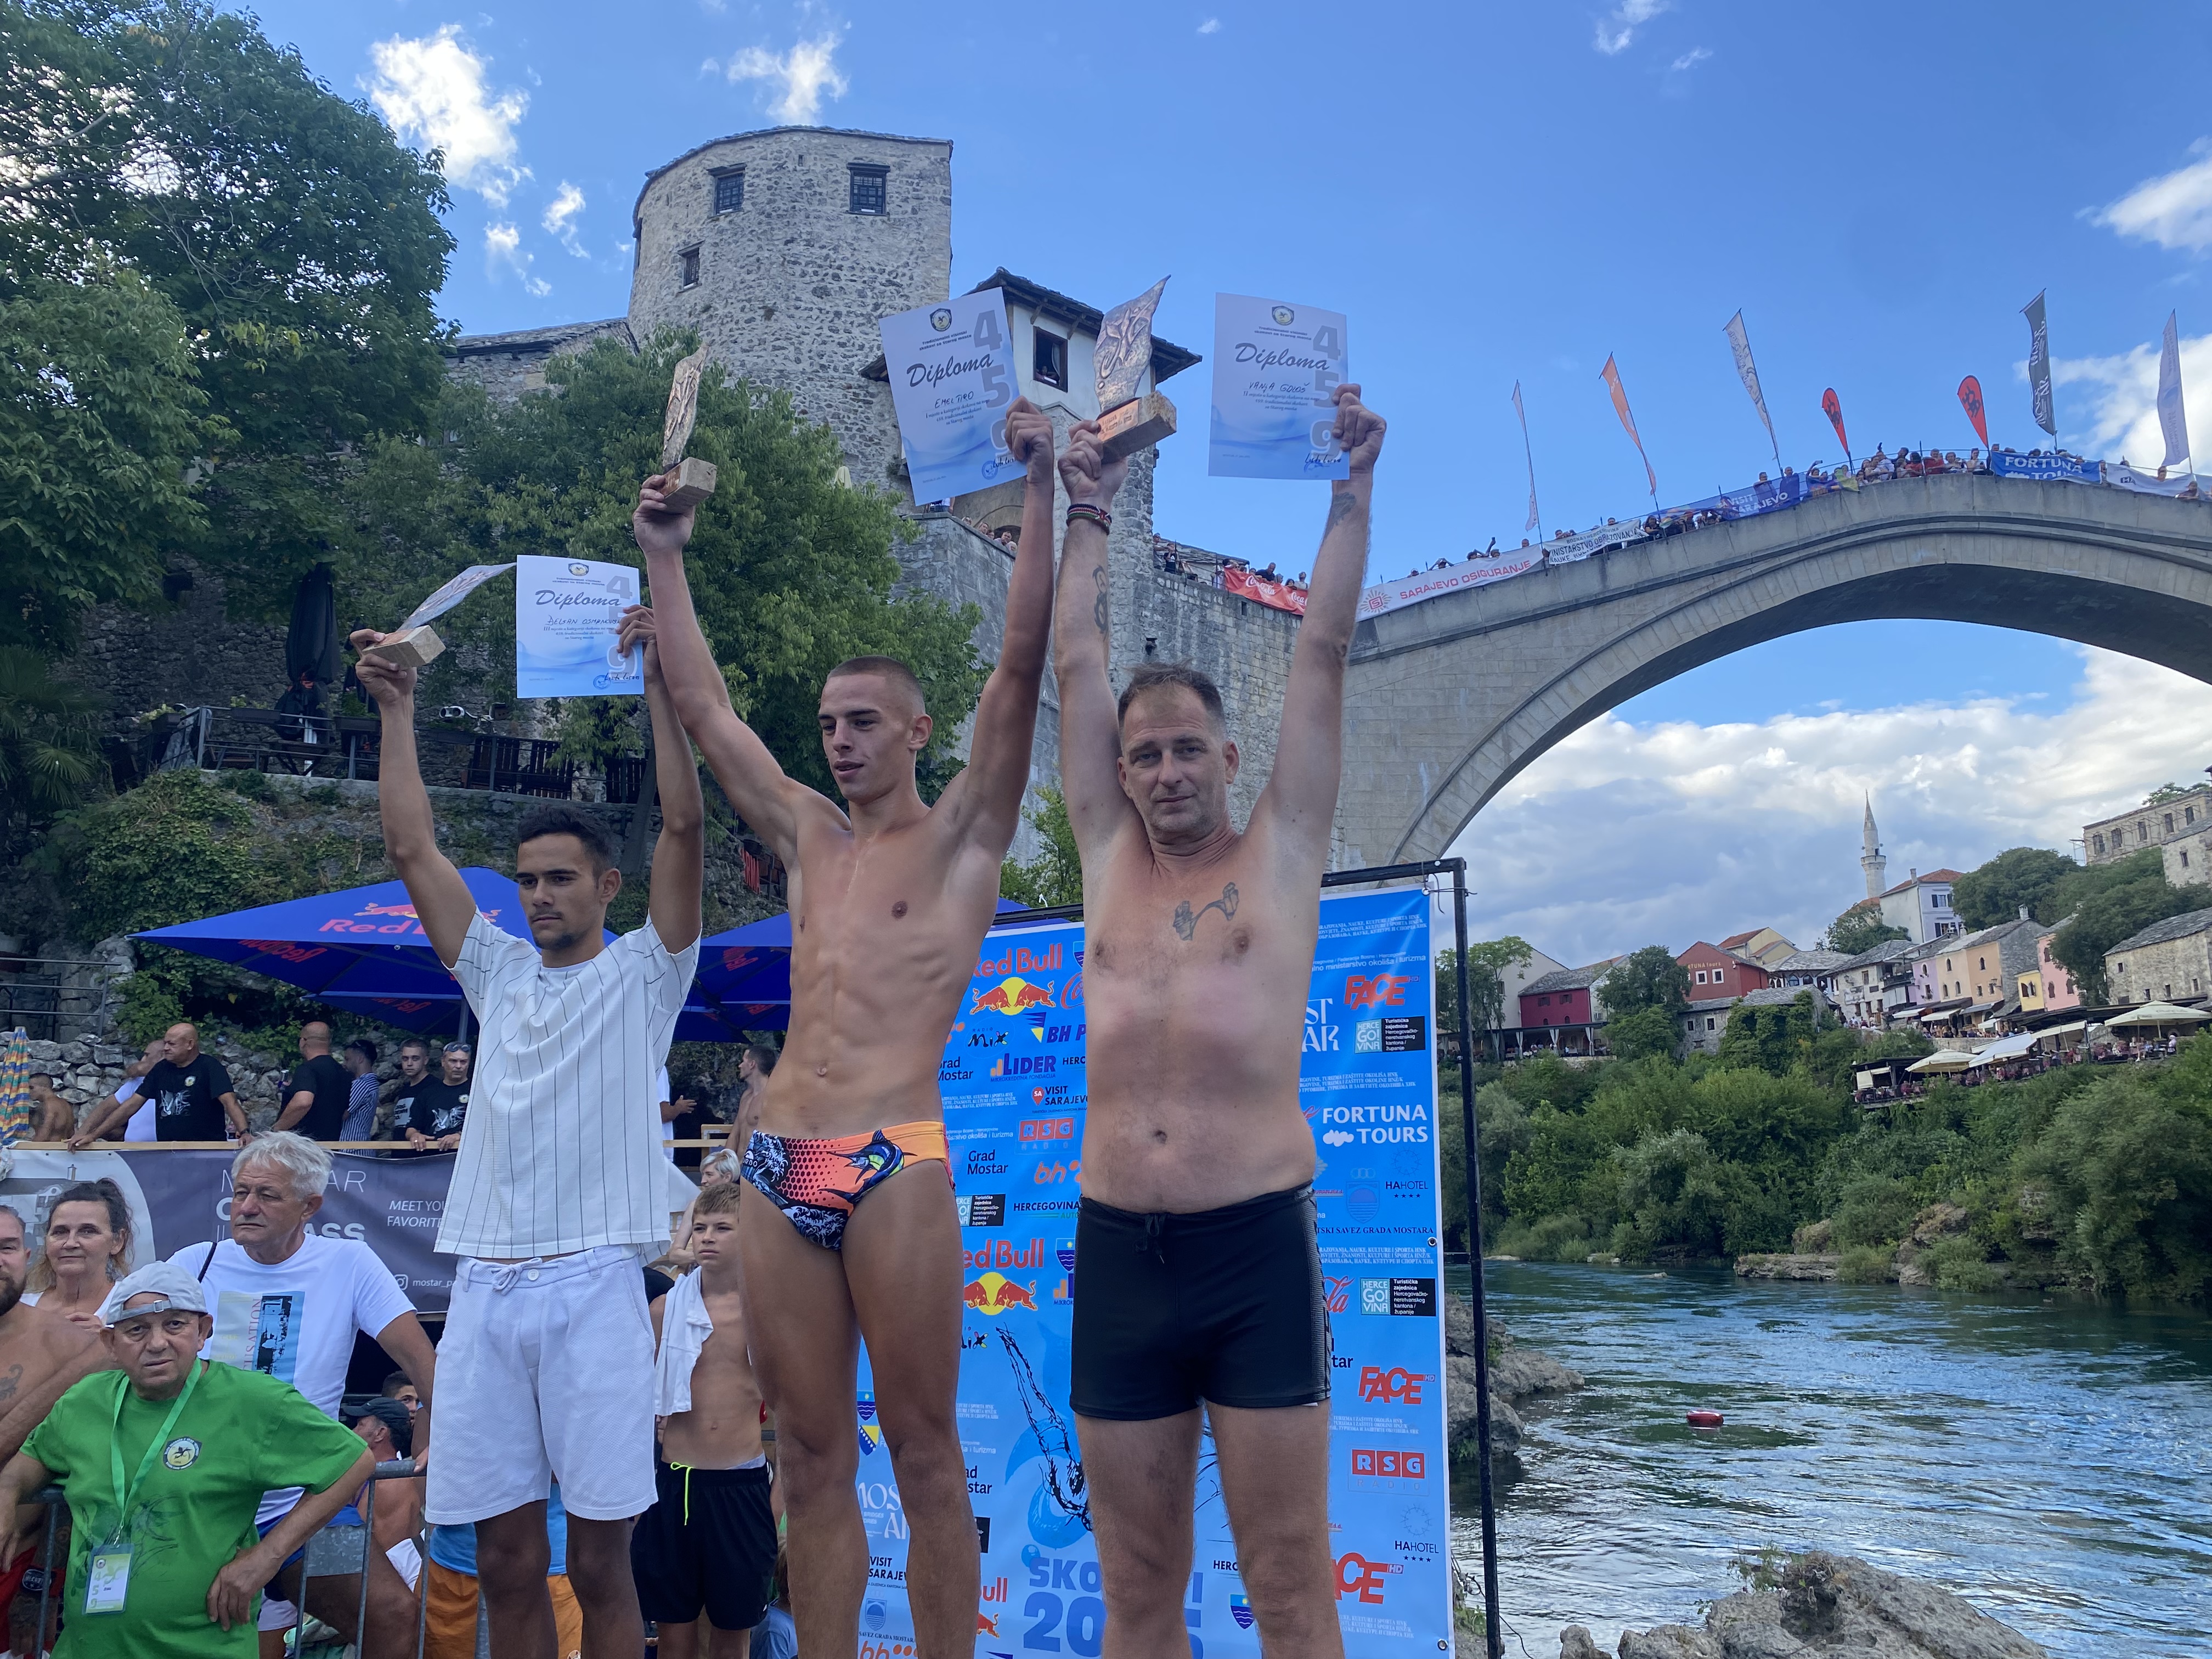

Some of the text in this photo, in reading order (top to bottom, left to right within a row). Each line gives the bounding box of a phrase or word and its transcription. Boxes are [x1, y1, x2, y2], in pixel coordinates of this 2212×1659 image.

[974, 310, 1003, 351] 4
[1313, 325, 1341, 361] 4
[1235, 343, 1330, 371] Diploma
[906, 354, 994, 388] Diploma
[981, 364, 1011, 408] 5
[2005, 456, 2084, 474] FORTUNA
[1728, 494, 1754, 506] VISIT
[1732, 492, 1788, 513] SARAJEVO
[606, 575, 633, 600] 4
[1400, 560, 1531, 600] SARAJEVO OSIGURANJE
[535, 590, 622, 610] Diploma
[318, 919, 414, 933] Red
[1016, 943, 1063, 974] Bull
[1325, 961, 1367, 971] ministarstvo
[1368, 958, 1394, 967] okoliša
[1399, 955, 1426, 963] turizma
[1344, 973, 1409, 1010] FACE
[1046, 1024, 1072, 1043] BH
[1357, 1022, 1380, 1030] HERCE
[1357, 1029, 1380, 1042] GO!
[1356, 1041, 1380, 1051] VINA
[1045, 1086, 1068, 1095] VISIT
[1323, 1104, 1427, 1124] FORTUNA
[1023, 1122, 1070, 1137] RSG
[1356, 1126, 1428, 1144] TOURS
[968, 1149, 996, 1162] Grad
[967, 1162, 1009, 1175] Mostar
[389, 1200, 423, 1211] MEET
[959, 1207, 969, 1216] O!
[1013, 1201, 1080, 1211] HERCEGOVINA
[964, 1238, 1045, 1269] ed Bull
[1362, 1280, 1387, 1289] HERCE
[1362, 1289, 1388, 1303] GO!
[1363, 1302, 1388, 1312] VINA
[1331, 1355, 1353, 1368] tar
[1358, 1366, 1425, 1405] FACE
[1357, 1454, 1421, 1474] RSG
[968, 1481, 992, 1494] star
[1394, 1540, 1439, 1554] HAHOTEL
[869, 1556, 893, 1567] VISIT
[983, 1577, 1008, 1602] ull
